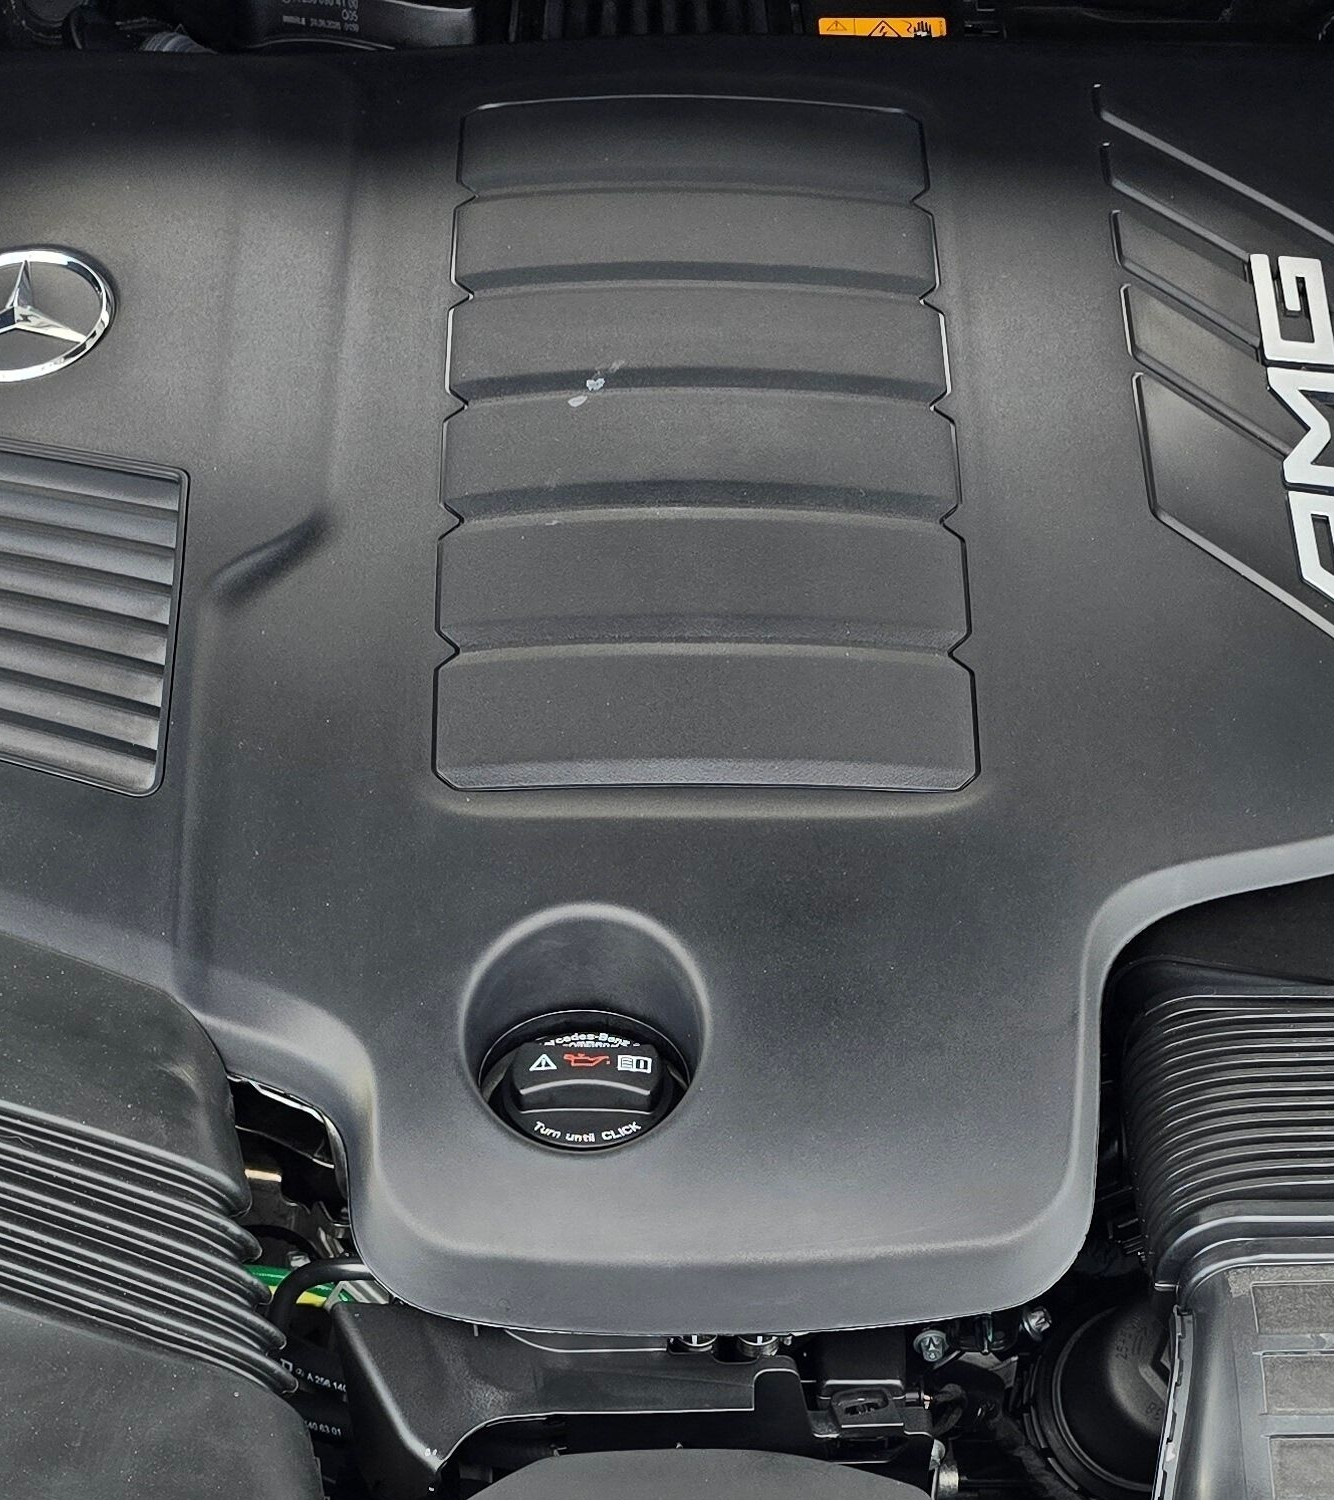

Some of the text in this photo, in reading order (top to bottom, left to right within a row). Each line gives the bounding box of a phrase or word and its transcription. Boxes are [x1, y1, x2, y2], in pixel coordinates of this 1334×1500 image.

[533, 1120, 642, 1143] Turn until CLICK
[306, 1372, 315, 1382] A
